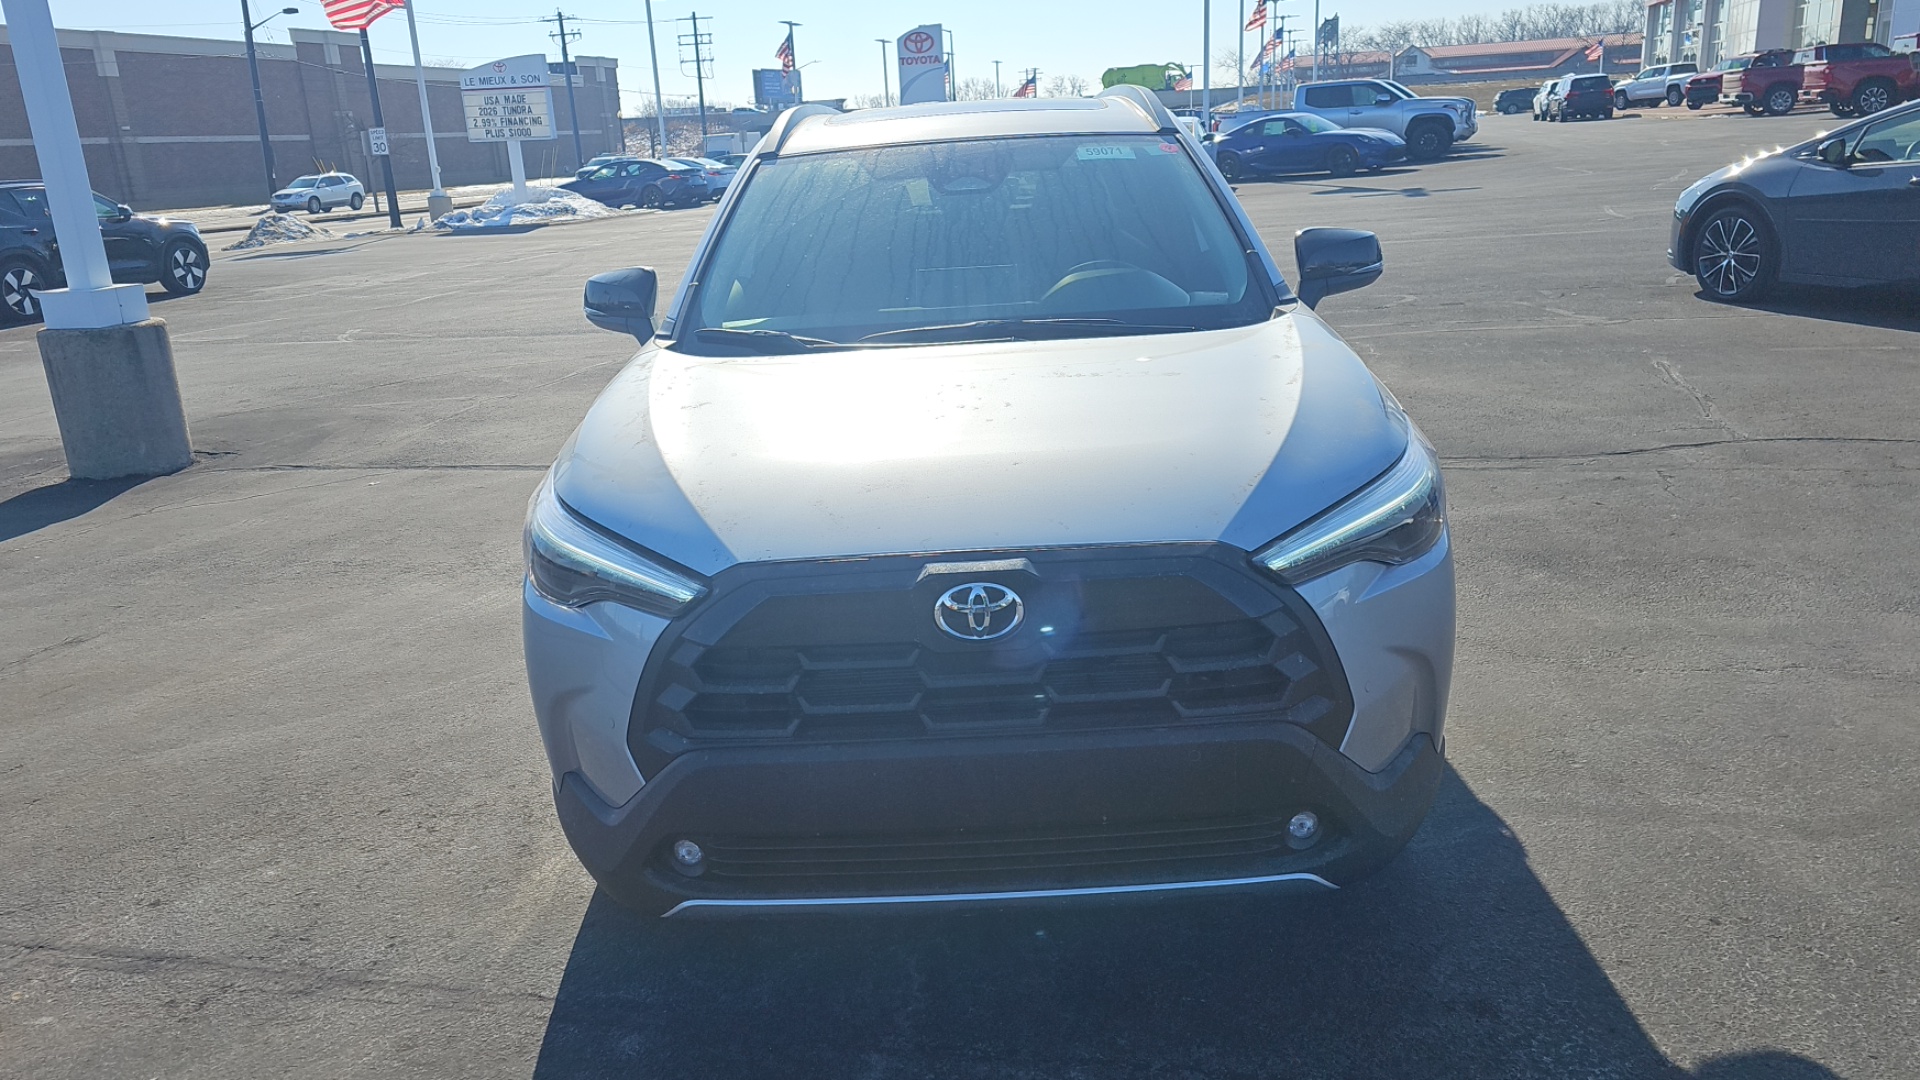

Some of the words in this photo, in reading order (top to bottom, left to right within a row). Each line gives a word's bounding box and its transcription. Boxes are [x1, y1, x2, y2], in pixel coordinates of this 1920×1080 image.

[899, 55, 941, 65] TOYOTA
[464, 77, 475, 86] LE
[479, 76, 507, 85] MIEUX
[510, 75, 517, 84] &
[520, 74, 541, 83] SON
[483, 95, 500, 105] USA
[504, 94, 527, 104] MADE
[478, 107, 498, 116] 2026
[502, 105, 533, 115] TUNDRA
[473, 118, 497, 127] 2.99%
[500, 116, 543, 127] FINANCING
[485, 129, 506, 138] PLUS
[373, 142, 387, 153] 30
[1085, 146, 1123, 156] 59071
